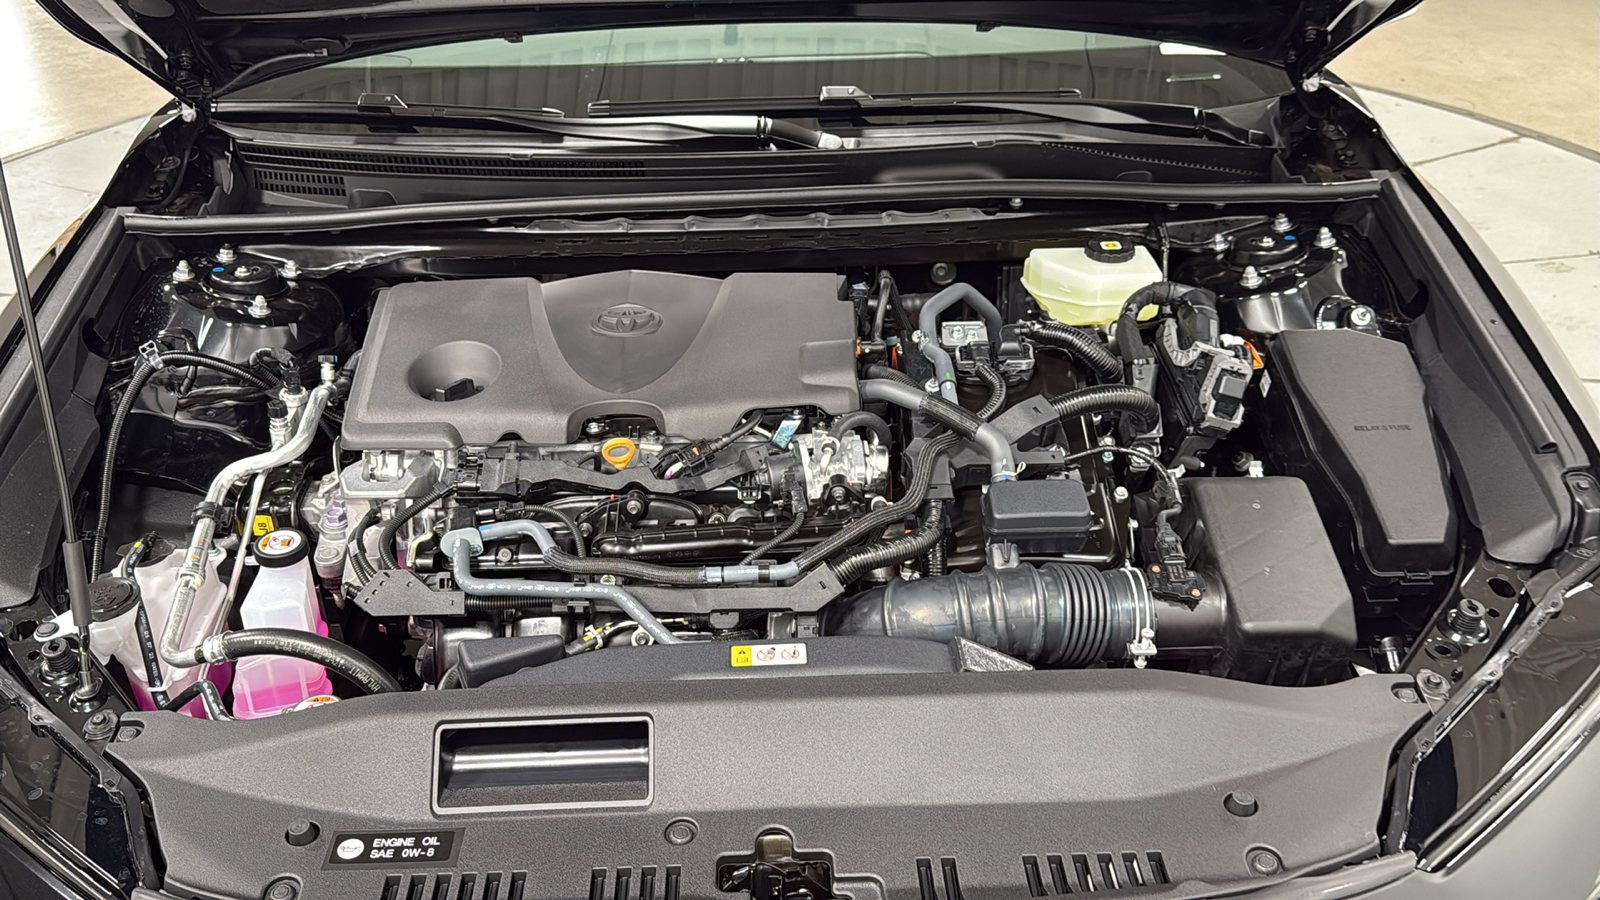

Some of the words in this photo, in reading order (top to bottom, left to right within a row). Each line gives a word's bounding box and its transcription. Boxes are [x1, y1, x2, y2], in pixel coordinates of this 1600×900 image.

[372, 837, 416, 848] ENGINE
[422, 836, 441, 846] OIL
[369, 849, 395, 859] SAE
[401, 848, 435, 858] 0W-8
